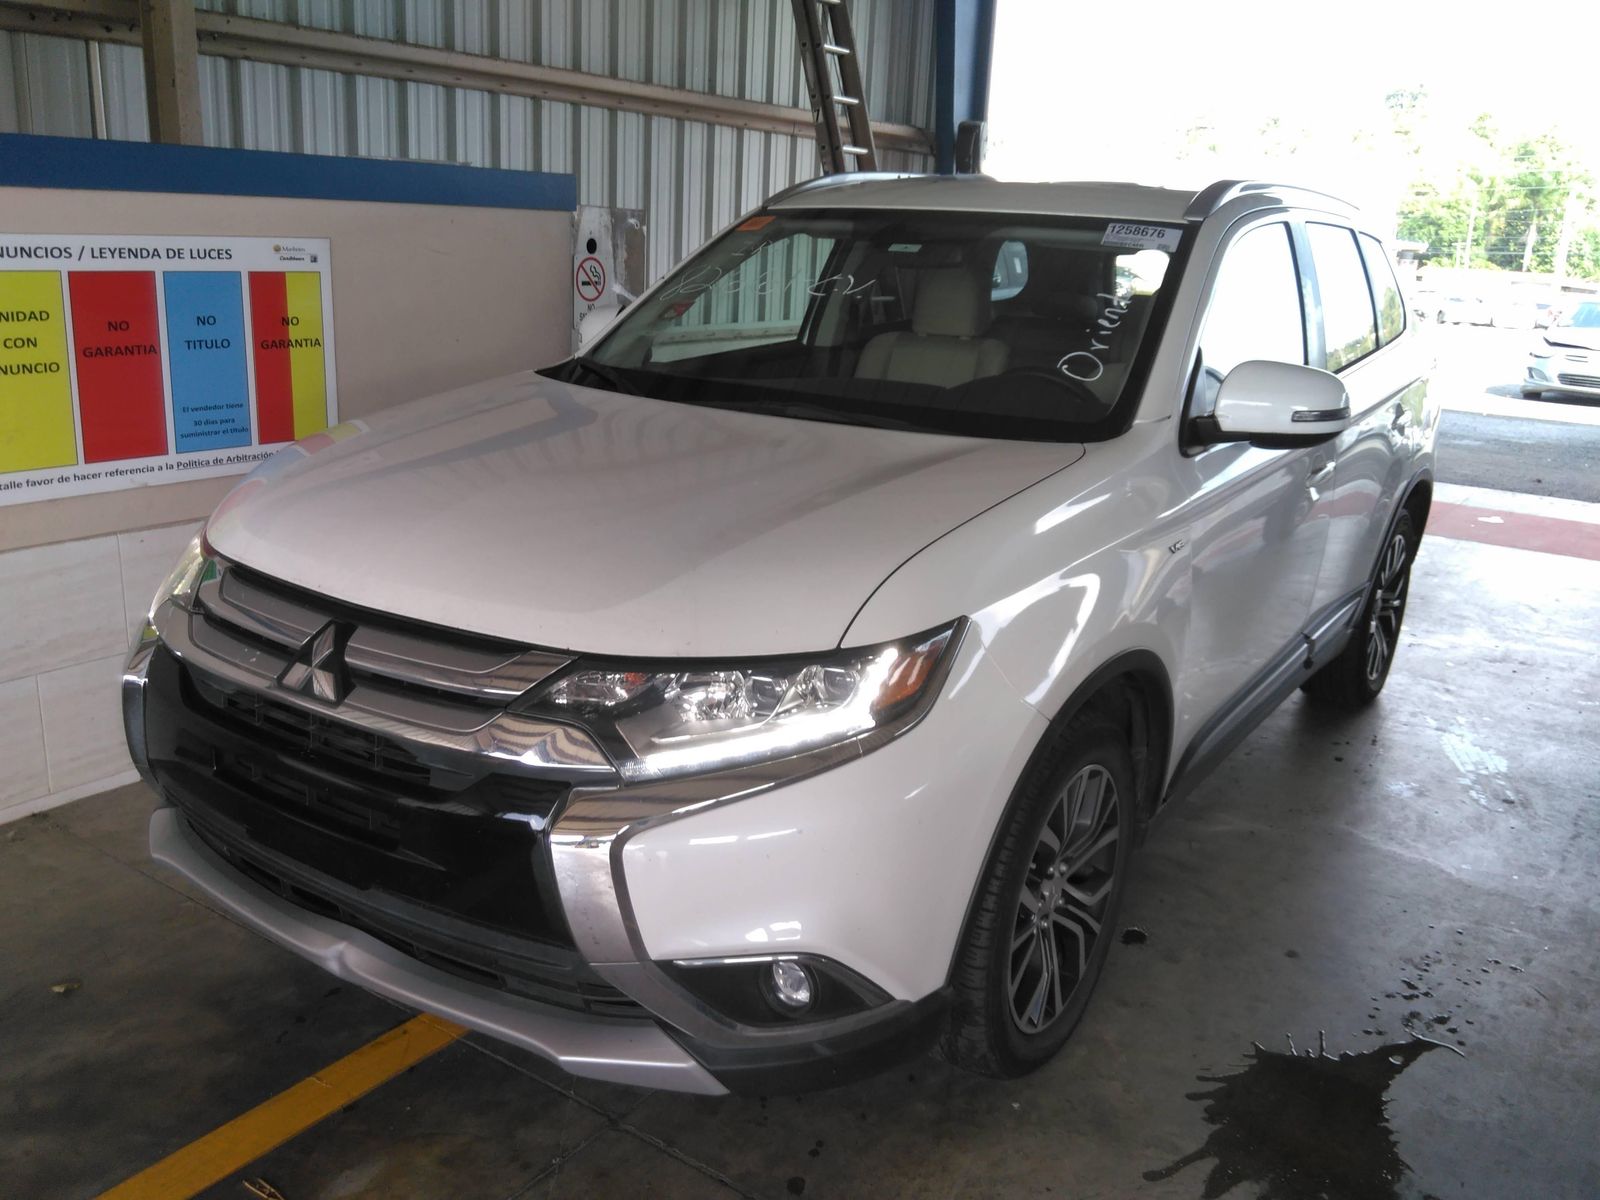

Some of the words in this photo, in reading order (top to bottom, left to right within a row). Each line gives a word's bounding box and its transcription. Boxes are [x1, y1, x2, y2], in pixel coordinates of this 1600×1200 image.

[1110, 224, 1166, 239] 1258676
[91, 246, 162, 260] LEYENDA
[166, 247, 185, 260] DE
[189, 248, 233, 260] LUCES
[107, 320, 130, 332] NO
[196, 315, 217, 327] NO
[281, 316, 300, 327] NO
[3, 337, 38, 349] CON
[184, 338, 231, 350] TITULO
[260, 338, 322, 350] GARANTIA
[82, 344, 157, 358] GARANTIA
[25, 478, 54, 488] favor
[57, 475, 71, 484] de
[73, 473, 101, 482] hacer
[105, 464, 155, 477] referencia
[165, 463, 175, 471] la
